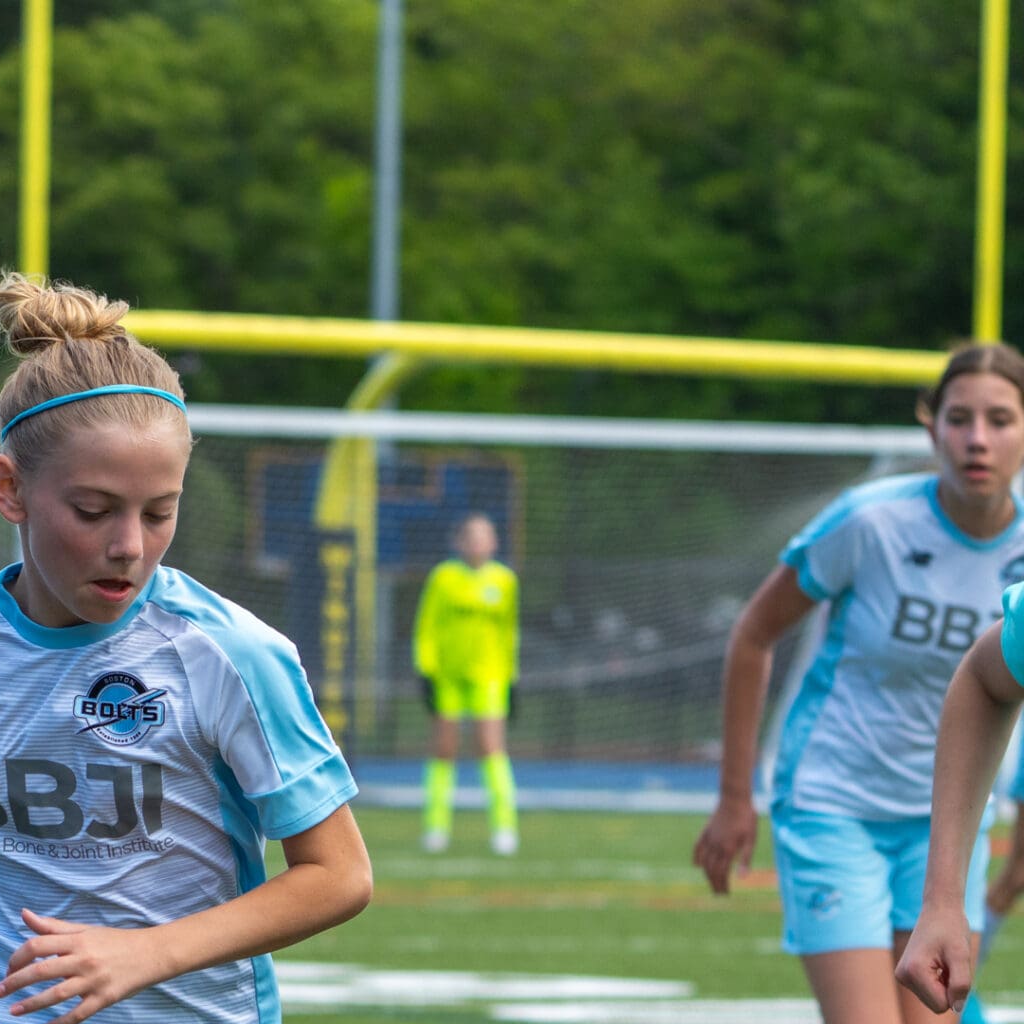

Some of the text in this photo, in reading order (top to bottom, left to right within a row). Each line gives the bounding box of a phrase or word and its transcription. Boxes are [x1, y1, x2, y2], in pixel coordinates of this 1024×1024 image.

[103, 675, 136, 686] BOSTON
[81, 701, 158, 722] BOLTS
[3, 837, 45, 855] Bone
[48, 844, 58, 858] &
[62, 844, 103, 860] Joint
[107, 835, 175, 859] Institute
